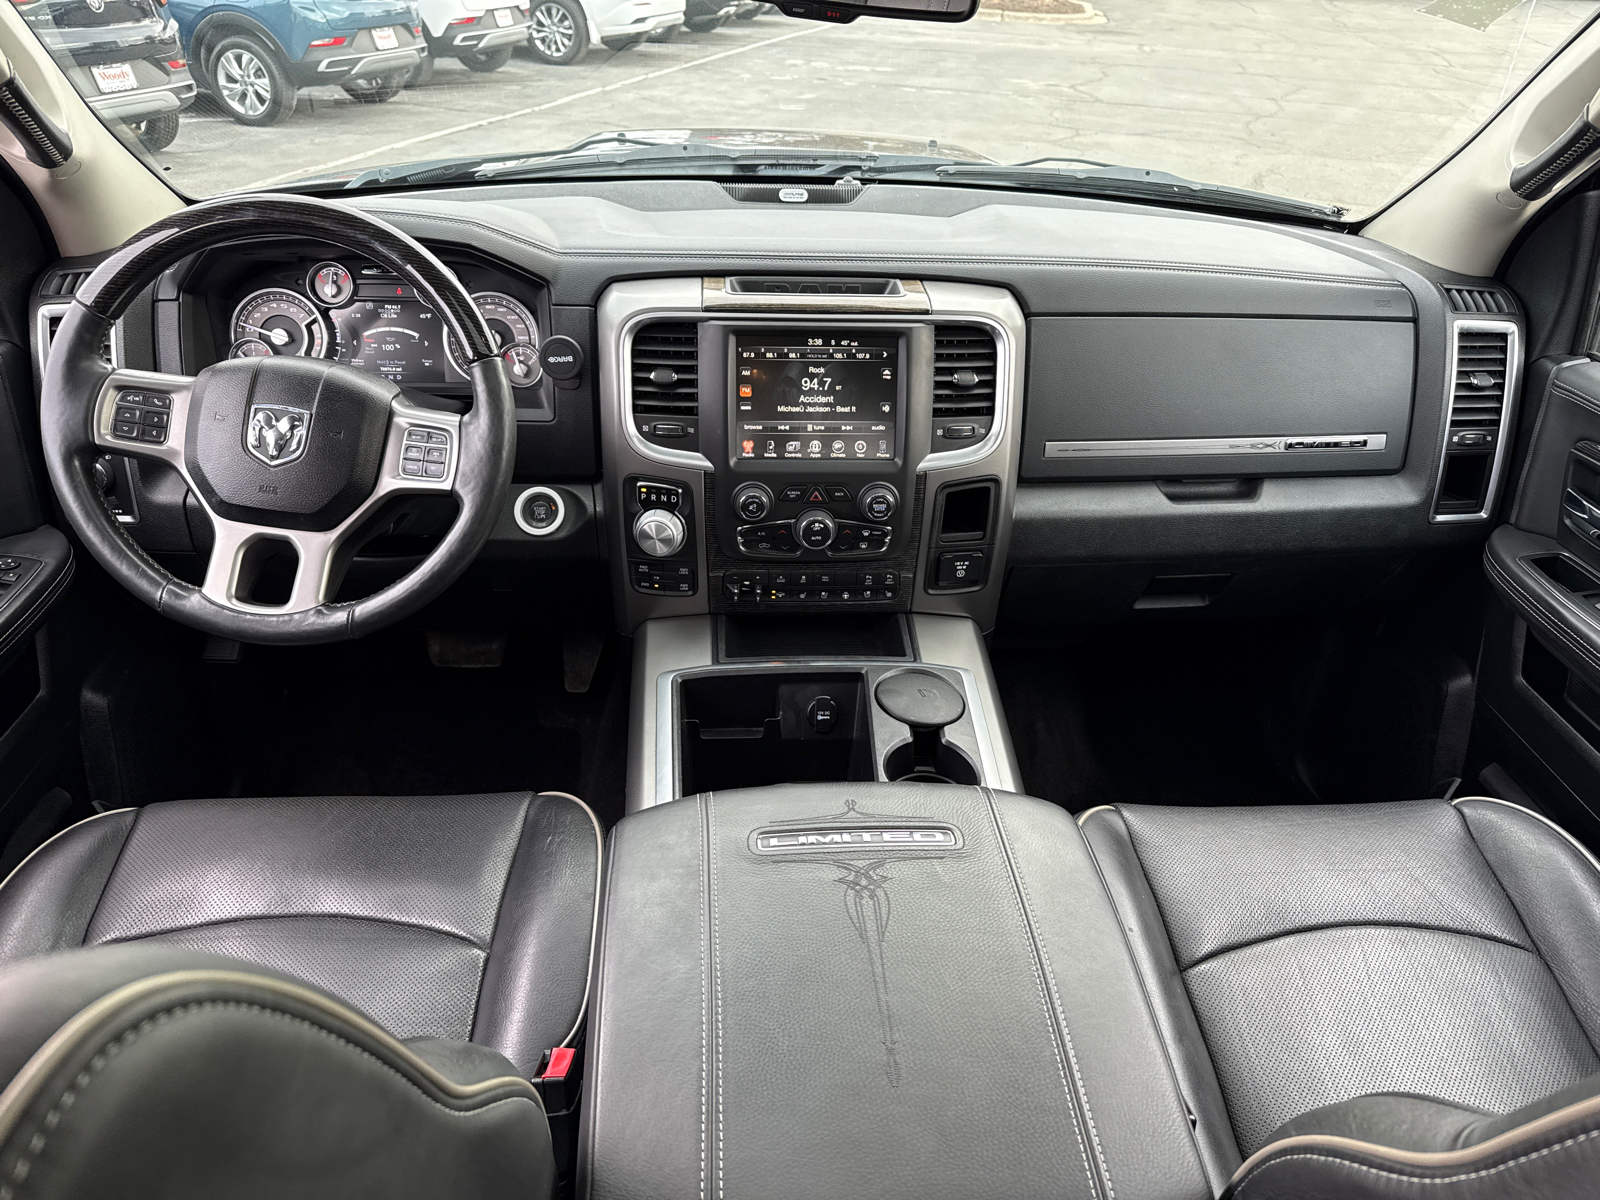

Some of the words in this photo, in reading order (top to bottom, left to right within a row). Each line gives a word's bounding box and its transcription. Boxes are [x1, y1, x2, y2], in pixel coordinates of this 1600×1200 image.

[98, 70, 130, 82] Woody
[801, 378, 832, 391] 94.7
[799, 395, 834, 403] Accident
[769, 831, 945, 846] LIMITED
